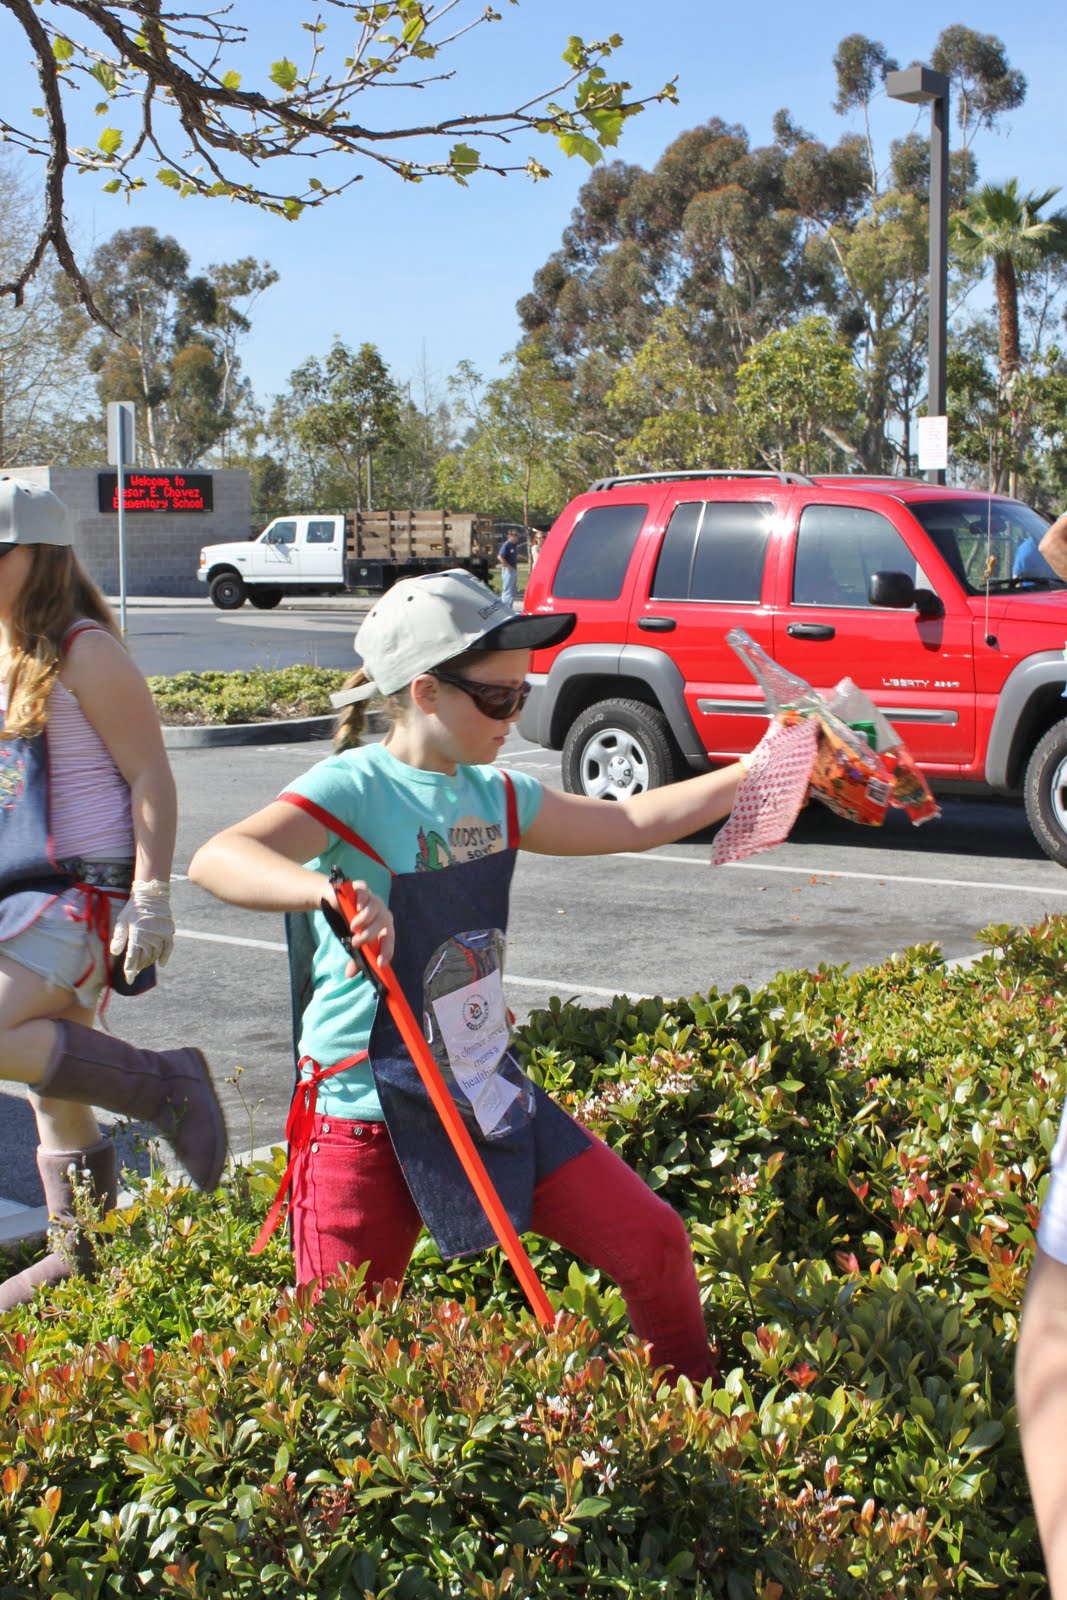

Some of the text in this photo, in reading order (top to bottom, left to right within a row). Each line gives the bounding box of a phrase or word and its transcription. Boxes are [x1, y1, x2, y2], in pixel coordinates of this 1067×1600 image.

[130, 475, 186, 486] Welcome to
[163, 486, 200, 497] Chavez
[113, 497, 204, 509] Eementary School
[882, 678, 929, 688] LIBERTY
